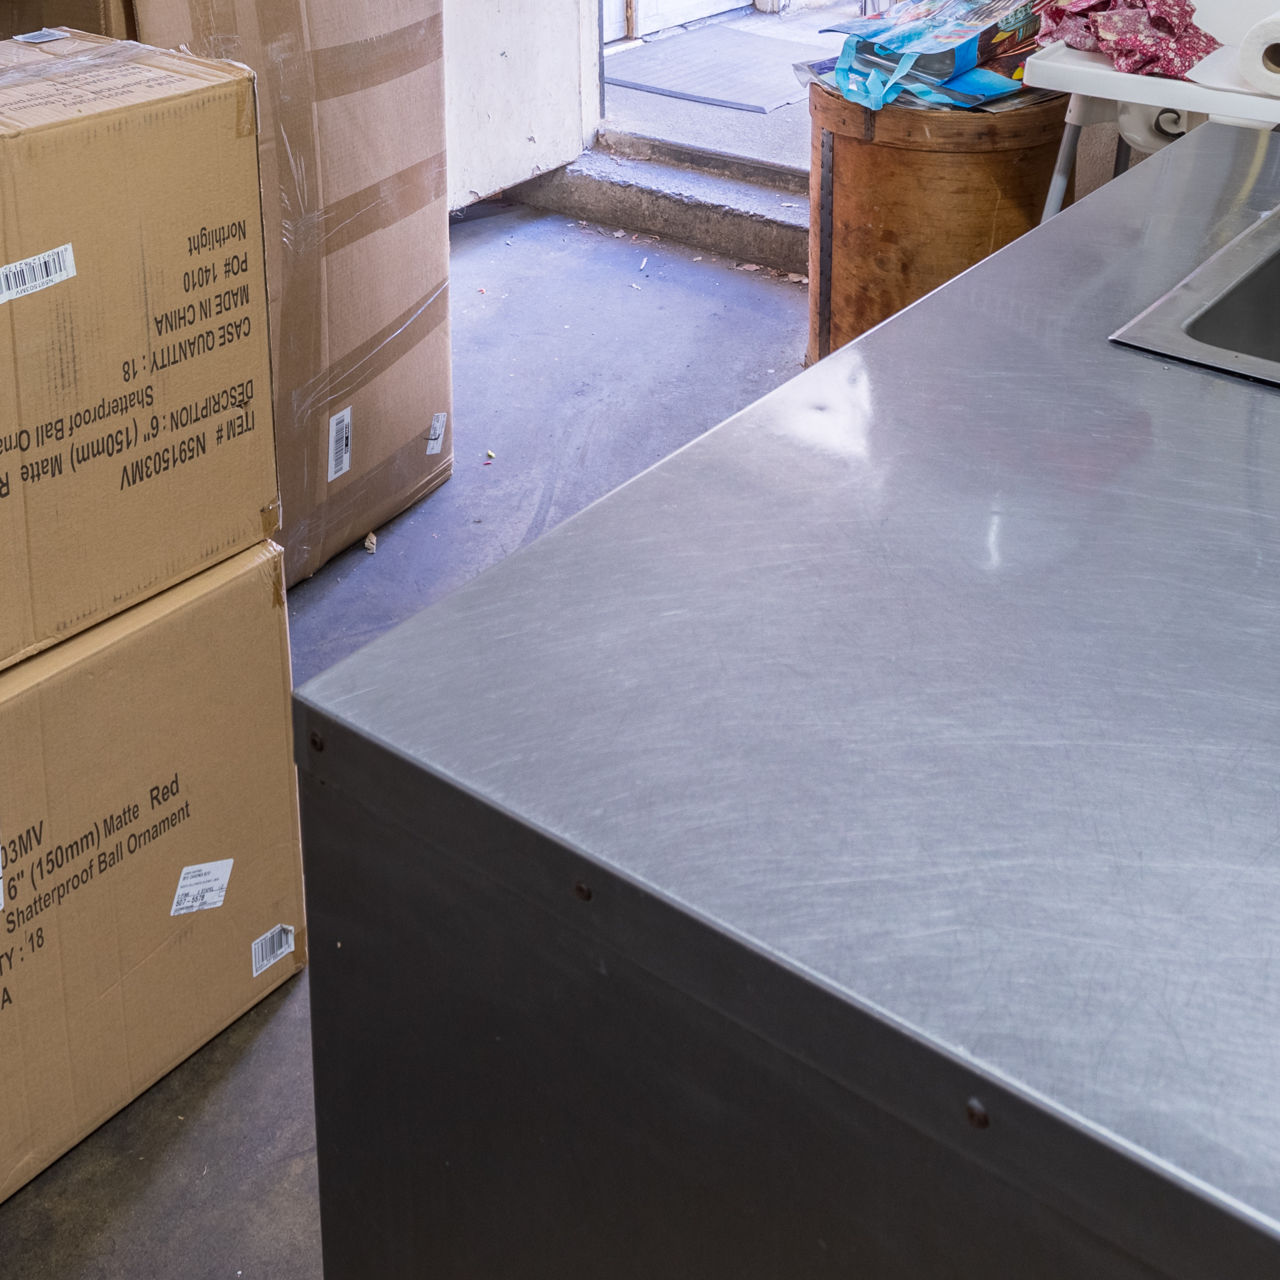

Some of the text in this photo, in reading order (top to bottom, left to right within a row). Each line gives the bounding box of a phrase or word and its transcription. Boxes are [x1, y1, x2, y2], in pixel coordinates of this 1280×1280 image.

[187, 220, 247, 256] Northlight
[183, 252, 248, 293] PO# 14010
[154, 284, 249, 337] MADE IN CHINA
[122, 316, 251, 382] CASE QUANTITY 18
[69, 385, 154, 436] Shatterproof
[170, 379, 254, 432] DESCRIPTION
[226, 410, 255, 440] ITEM
[36, 419, 65, 448] Ball
[71, 418, 139, 472] (150mm)
[21, 453, 63, 483] Matte
[120, 431, 206, 491] N591503MV
[7, 773, 180, 899] 6" (150mm) Matte Red
[5, 801, 191, 935] Shatterproof Ball Ornament
[29, 927, 45, 953] 18
